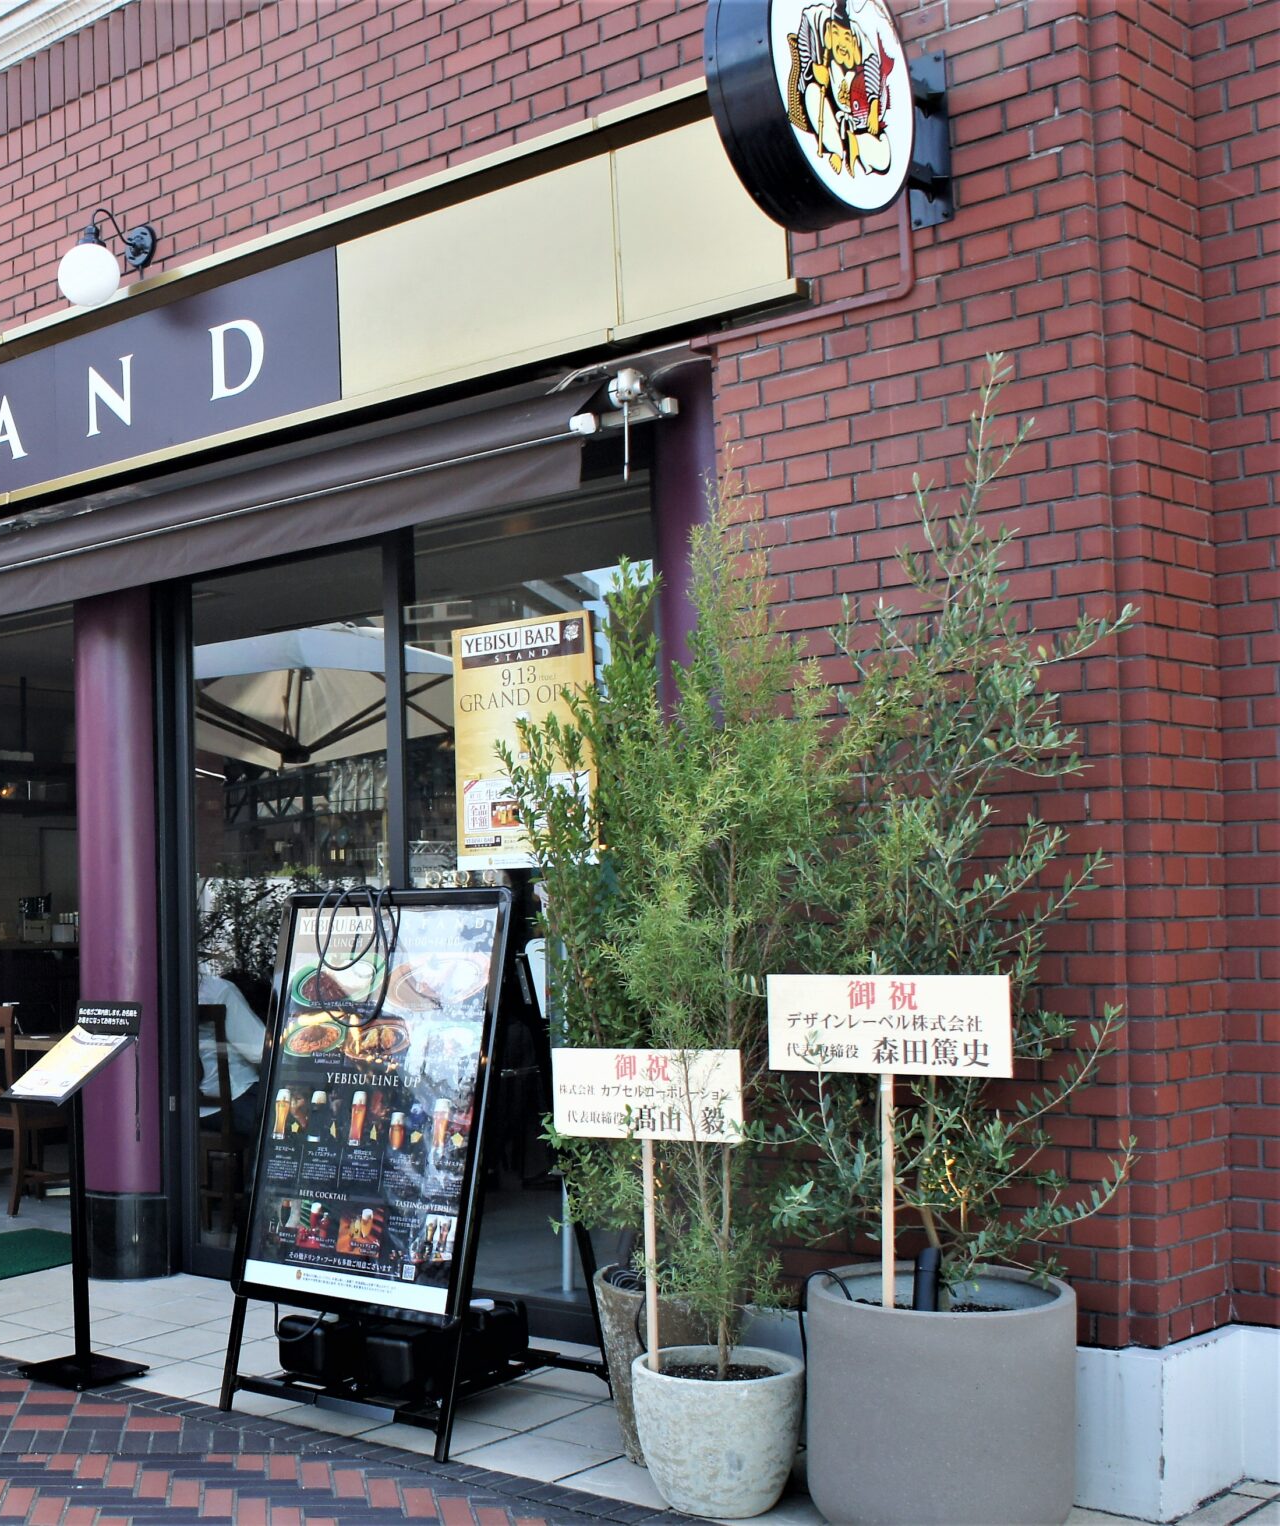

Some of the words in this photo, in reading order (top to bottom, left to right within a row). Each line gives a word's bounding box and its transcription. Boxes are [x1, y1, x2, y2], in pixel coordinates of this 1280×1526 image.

[464, 631, 518, 654] YEBISU
[524, 626, 557, 646] BAR
[494, 648, 550, 664] STAND
[501, 665, 537, 687] 9.13
[460, 687, 531, 713] GRAND
[348, 917, 373, 934] BAR
[786, 1012, 983, 1033] デザインレーベル株式会社
[872, 1037, 990, 1067] 森田篤史
[326, 1072, 367, 1085] YEBISU
[371, 1074, 399, 1087] LINE
[403, 1077, 421, 1088] UP
[559, 1084, 595, 1096] 株式会社
[299, 1189, 314, 1198] BEER
[315, 1191, 347, 1201] COCKTAIL
[395, 1200, 422, 1210] TASTING
